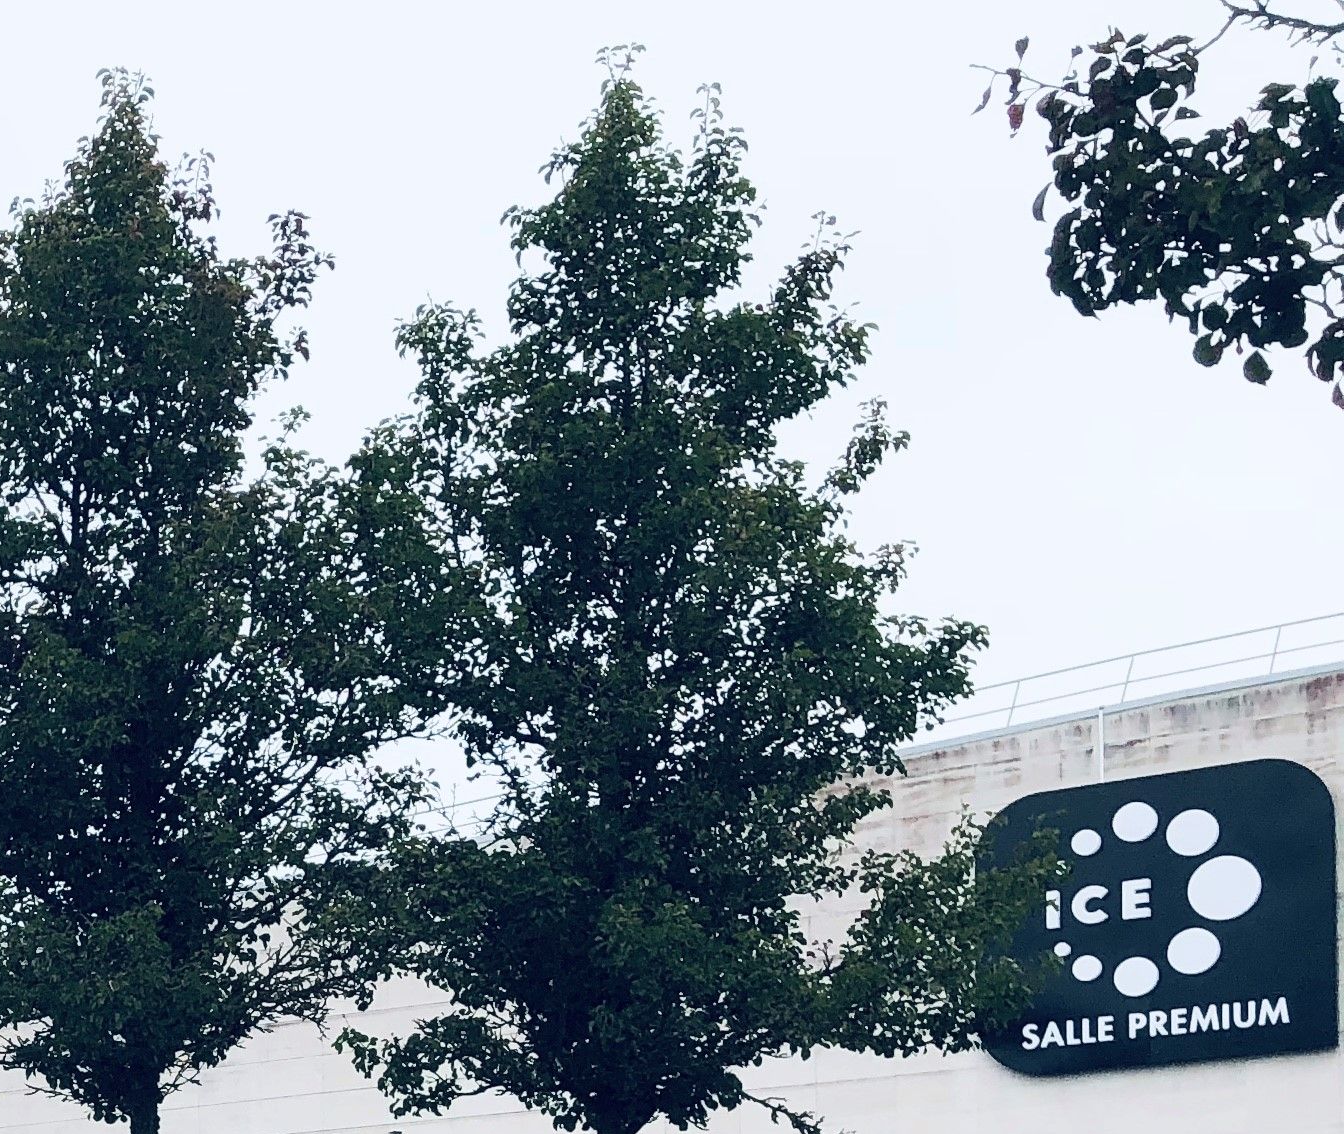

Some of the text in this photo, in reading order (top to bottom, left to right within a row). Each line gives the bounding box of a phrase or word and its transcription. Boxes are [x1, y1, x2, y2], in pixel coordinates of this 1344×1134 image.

[1045, 878, 1152, 930] ICE
[1021, 997, 1291, 1051] SALLE PREMIUM
